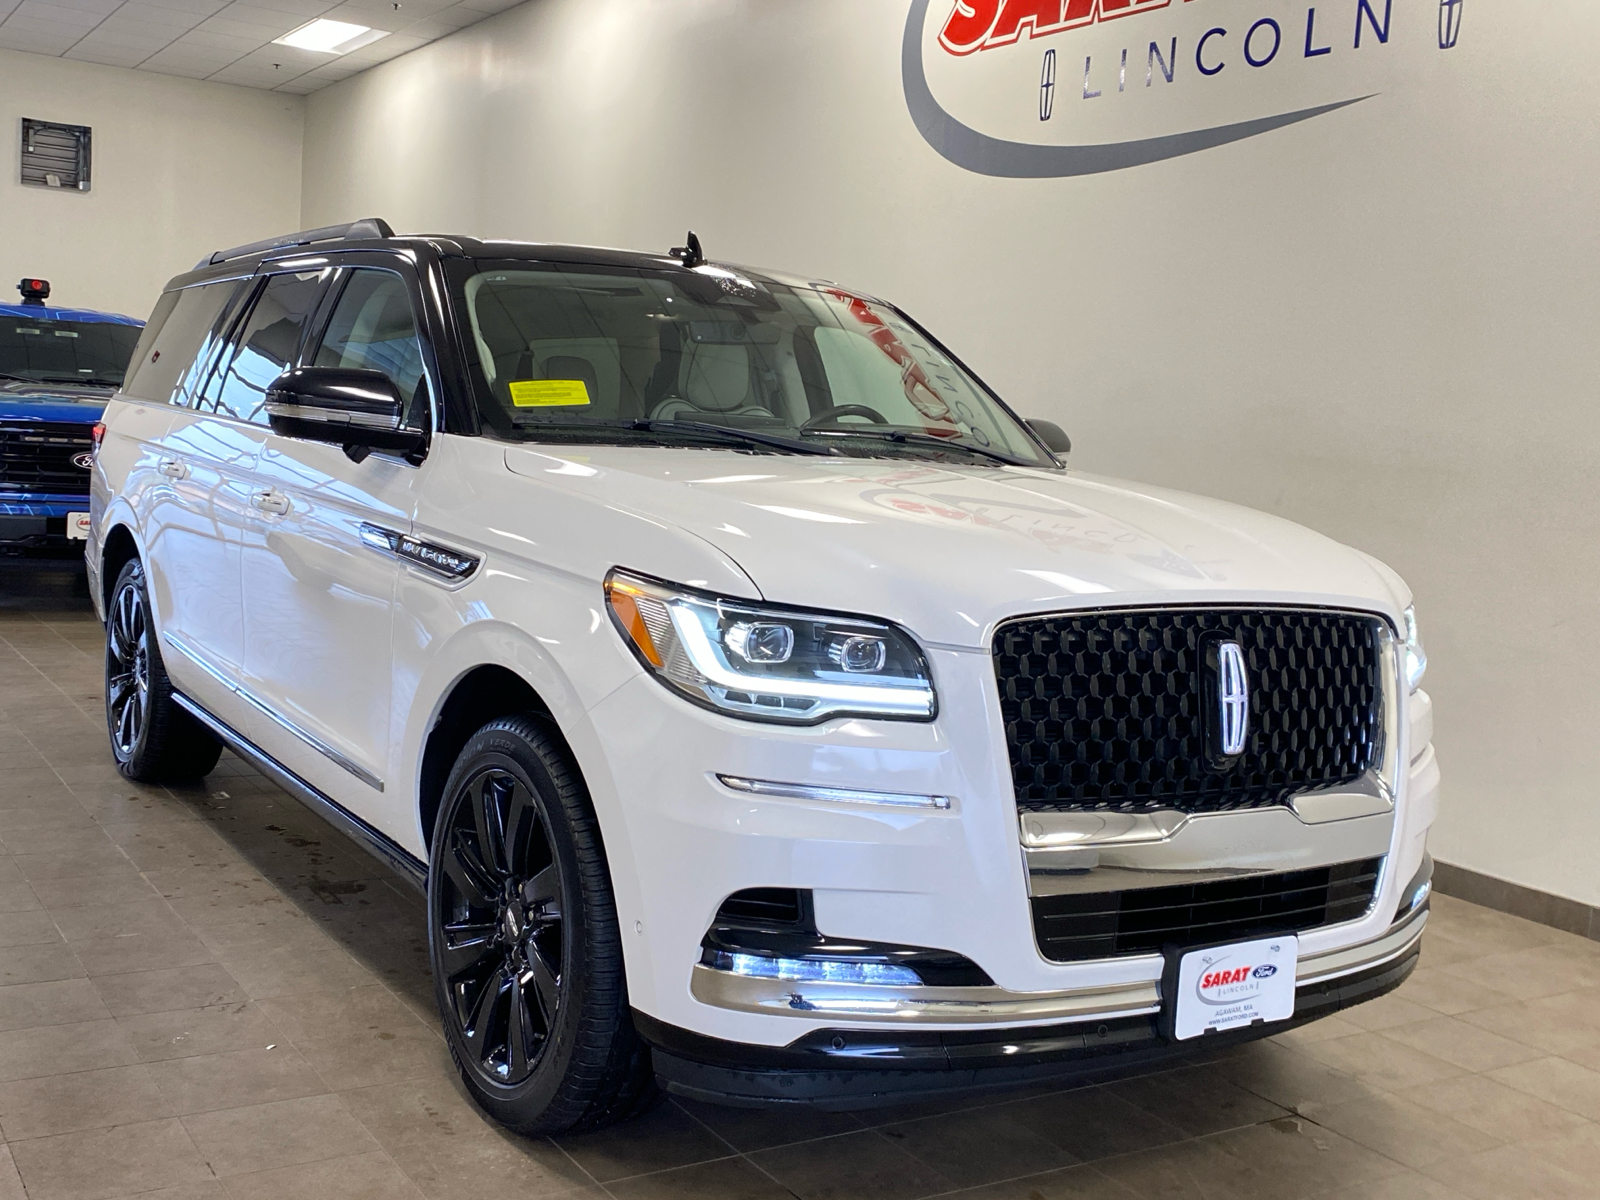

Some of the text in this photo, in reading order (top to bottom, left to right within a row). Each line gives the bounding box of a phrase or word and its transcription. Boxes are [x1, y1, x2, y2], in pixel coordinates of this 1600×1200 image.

[1083, 0, 1392, 99] LINCOLN
[1202, 965, 1275, 989] SARAT Ford
[1222, 984, 1254, 995] LINCOLN
